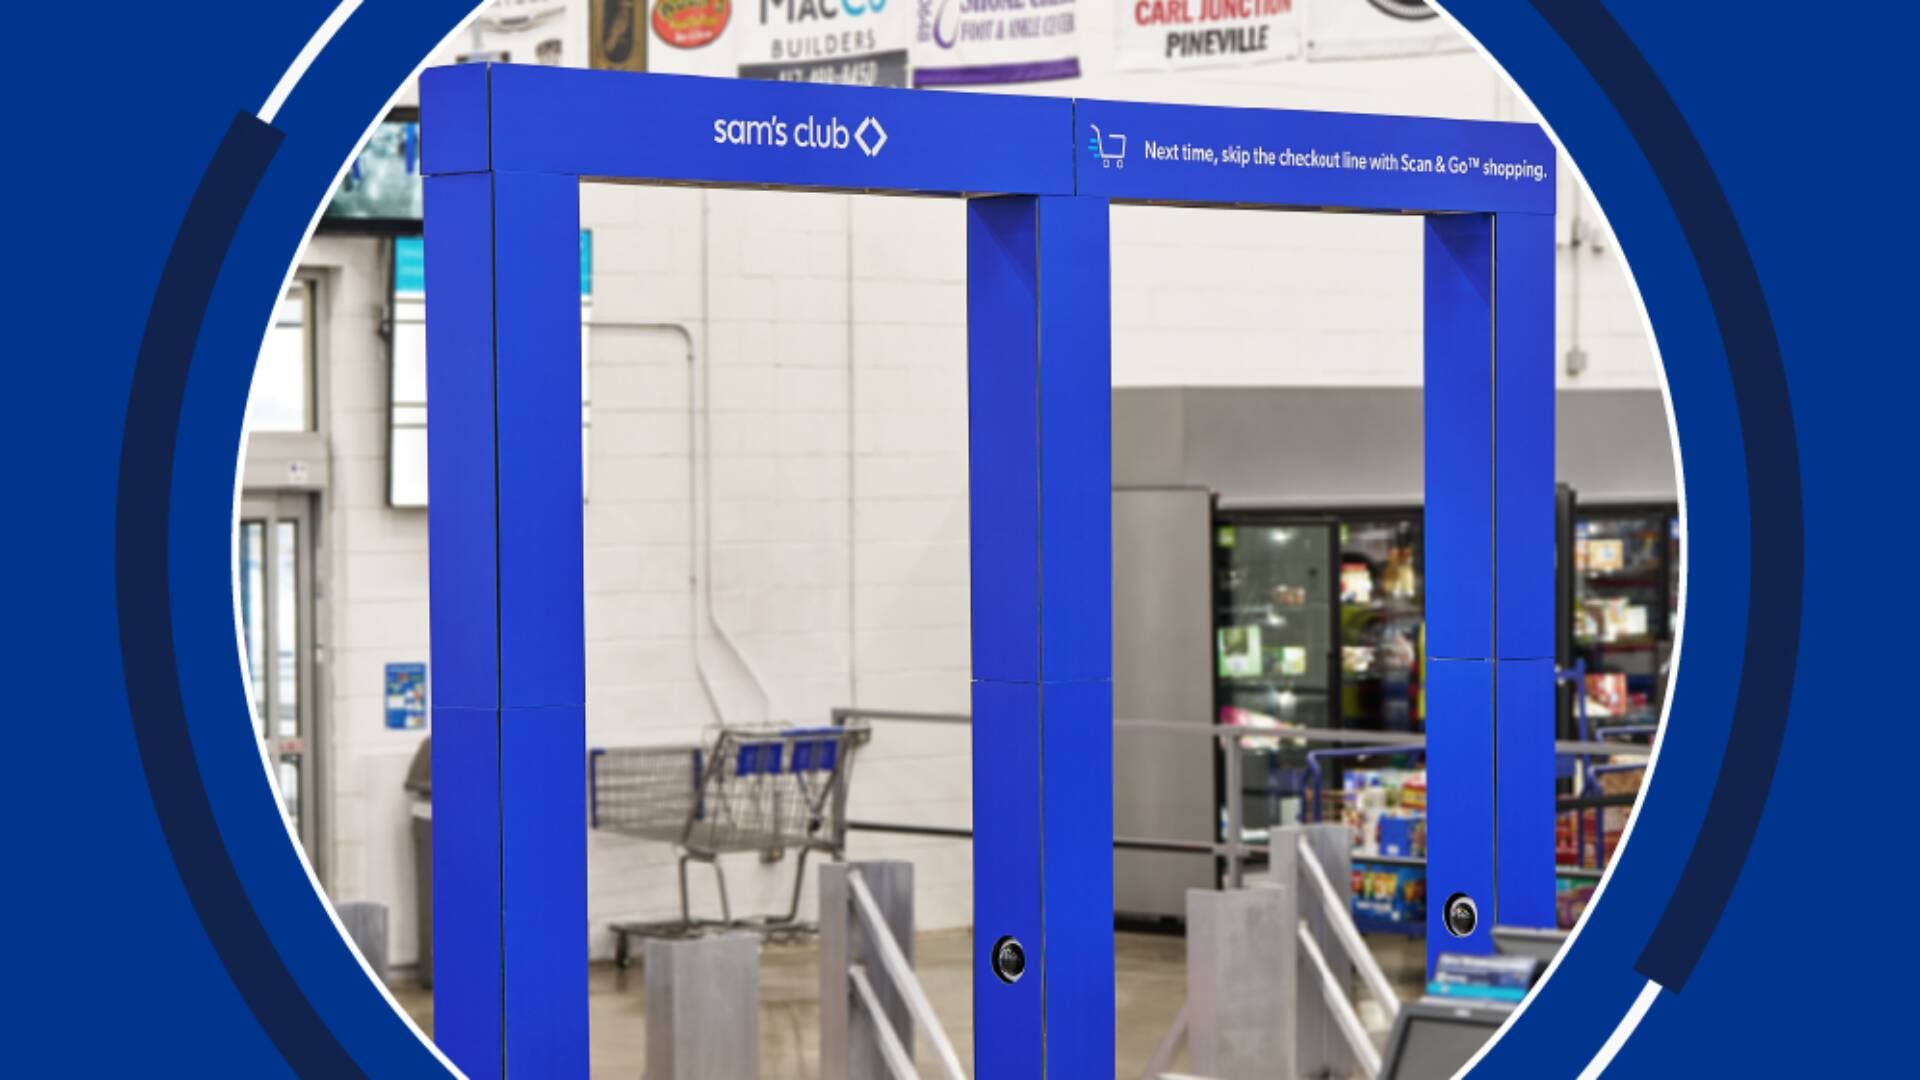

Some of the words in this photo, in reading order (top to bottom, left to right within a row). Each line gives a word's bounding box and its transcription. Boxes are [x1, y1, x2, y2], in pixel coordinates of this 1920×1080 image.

[1134, 0, 1194, 27] CARL
[770, 29, 876, 60] BUILDERS
[1165, 25, 1270, 58] PINEVILLE
[713, 115, 788, 147] sam's
[793, 115, 850, 150] club
[1144, 140, 1180, 161] Next
[1182, 143, 1219, 167] time,
[1221, 145, 1250, 169] skip
[1253, 146, 1276, 166] the
[1279, 148, 1341, 169] checkout
[1342, 151, 1367, 170] line
[1369, 153, 1399, 171] with
[1401, 153, 1433, 173] Scan
[1435, 155, 1446, 174] &
[1482, 157, 1549, 182] shopping.
